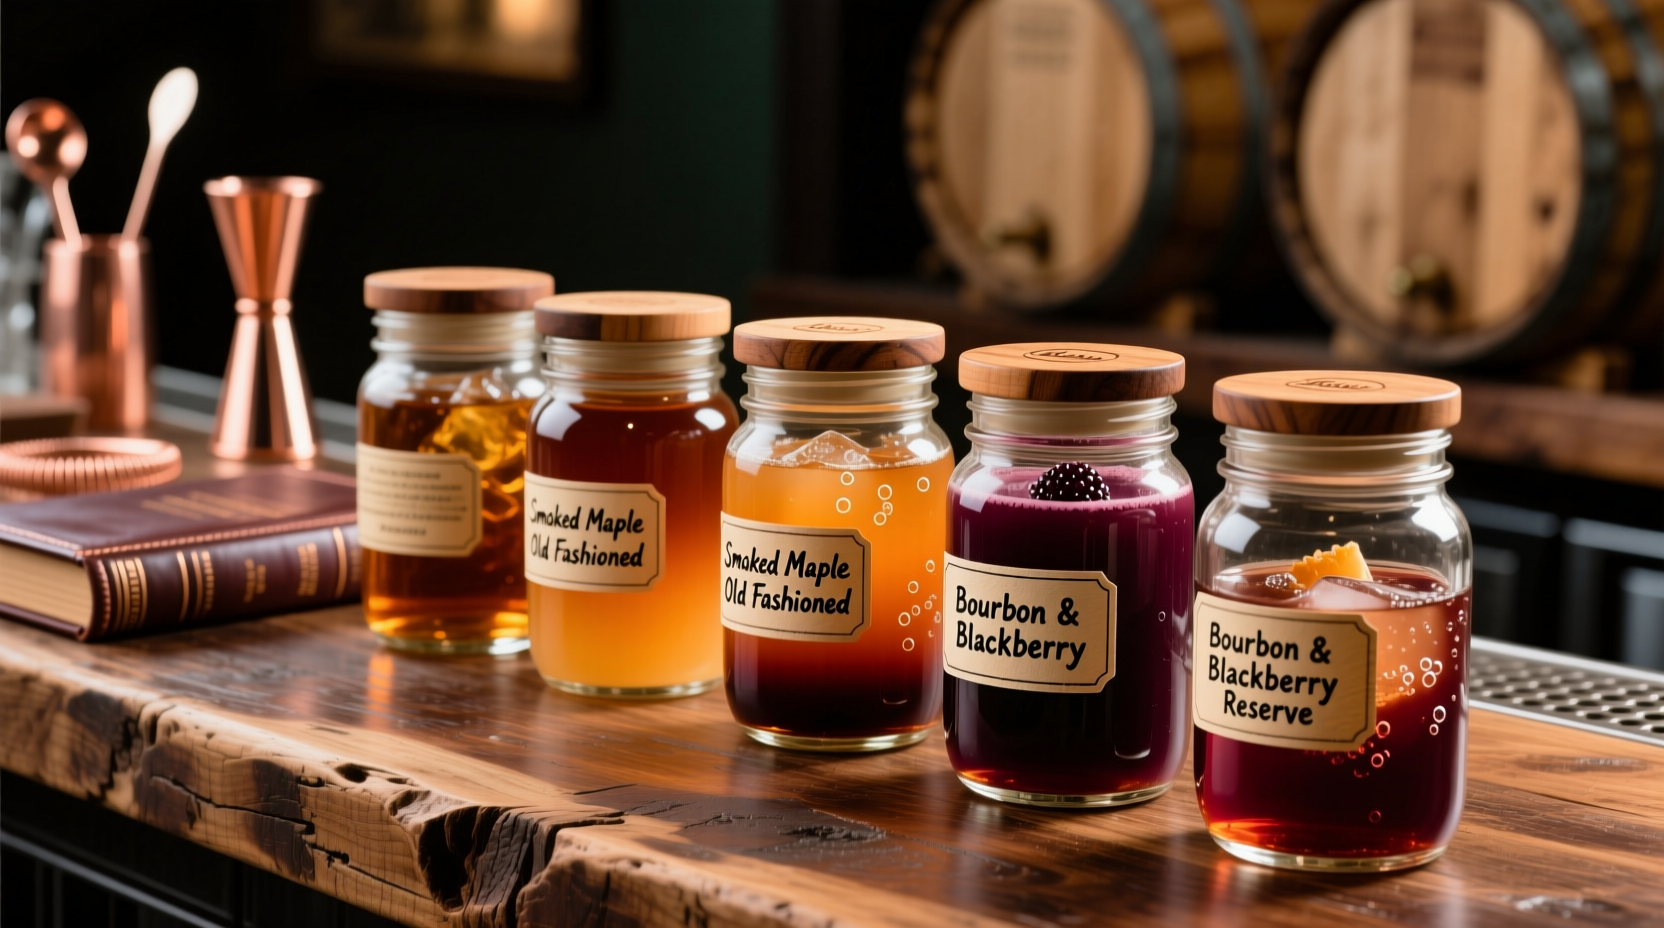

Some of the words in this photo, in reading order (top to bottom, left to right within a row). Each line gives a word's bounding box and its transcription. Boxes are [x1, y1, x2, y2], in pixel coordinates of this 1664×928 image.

[529, 497, 580, 531] Smoked
[586, 508, 645, 541] Maple
[530, 532, 549, 561] Old
[554, 538, 645, 568] Fashioned
[784, 550, 851, 588] Maple
[724, 576, 747, 606] Old
[751, 582, 853, 615] Fashioned
[955, 584, 1046, 626] Bourbon
[1057, 596, 1080, 627] &
[955, 620, 1087, 671] Blackberry
[1209, 621, 1299, 661] Bourbon
[1309, 635, 1332, 665] &
[1208, 654, 1339, 707] Blackberry
[1223, 689, 1314, 726] Reserve
